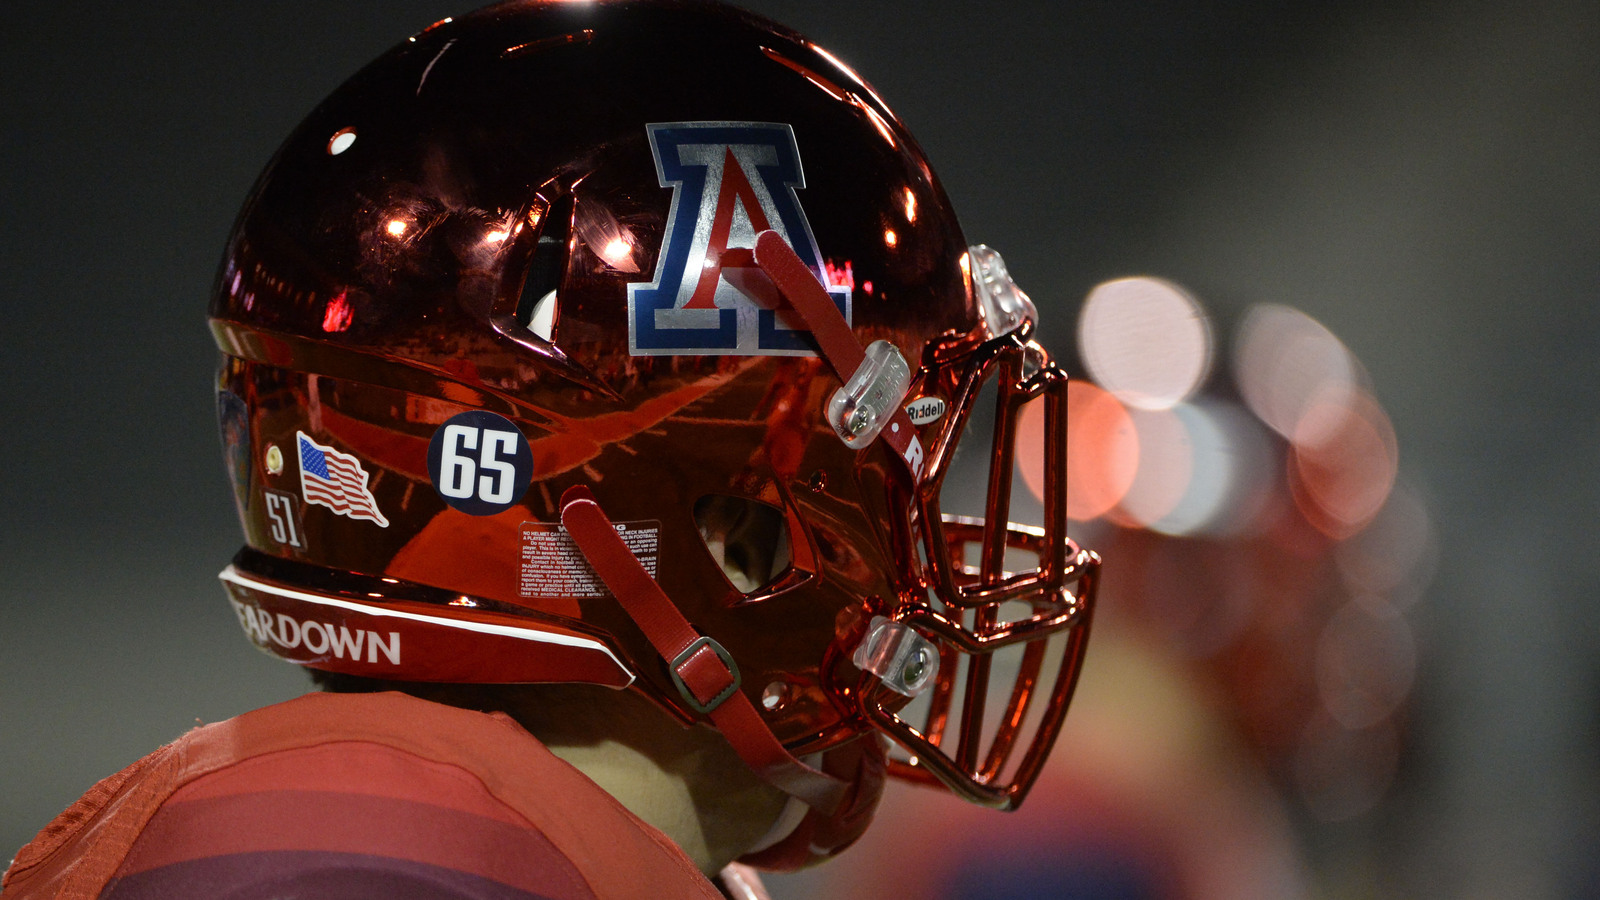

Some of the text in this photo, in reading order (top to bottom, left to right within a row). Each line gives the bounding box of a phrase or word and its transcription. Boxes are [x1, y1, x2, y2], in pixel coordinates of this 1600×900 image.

[627, 121, 852, 357] A
[908, 402, 943, 420] Riddell
[440, 424, 518, 504] 65
[265, 492, 301, 548] 51
[235, 601, 401, 665] EARDOWN
